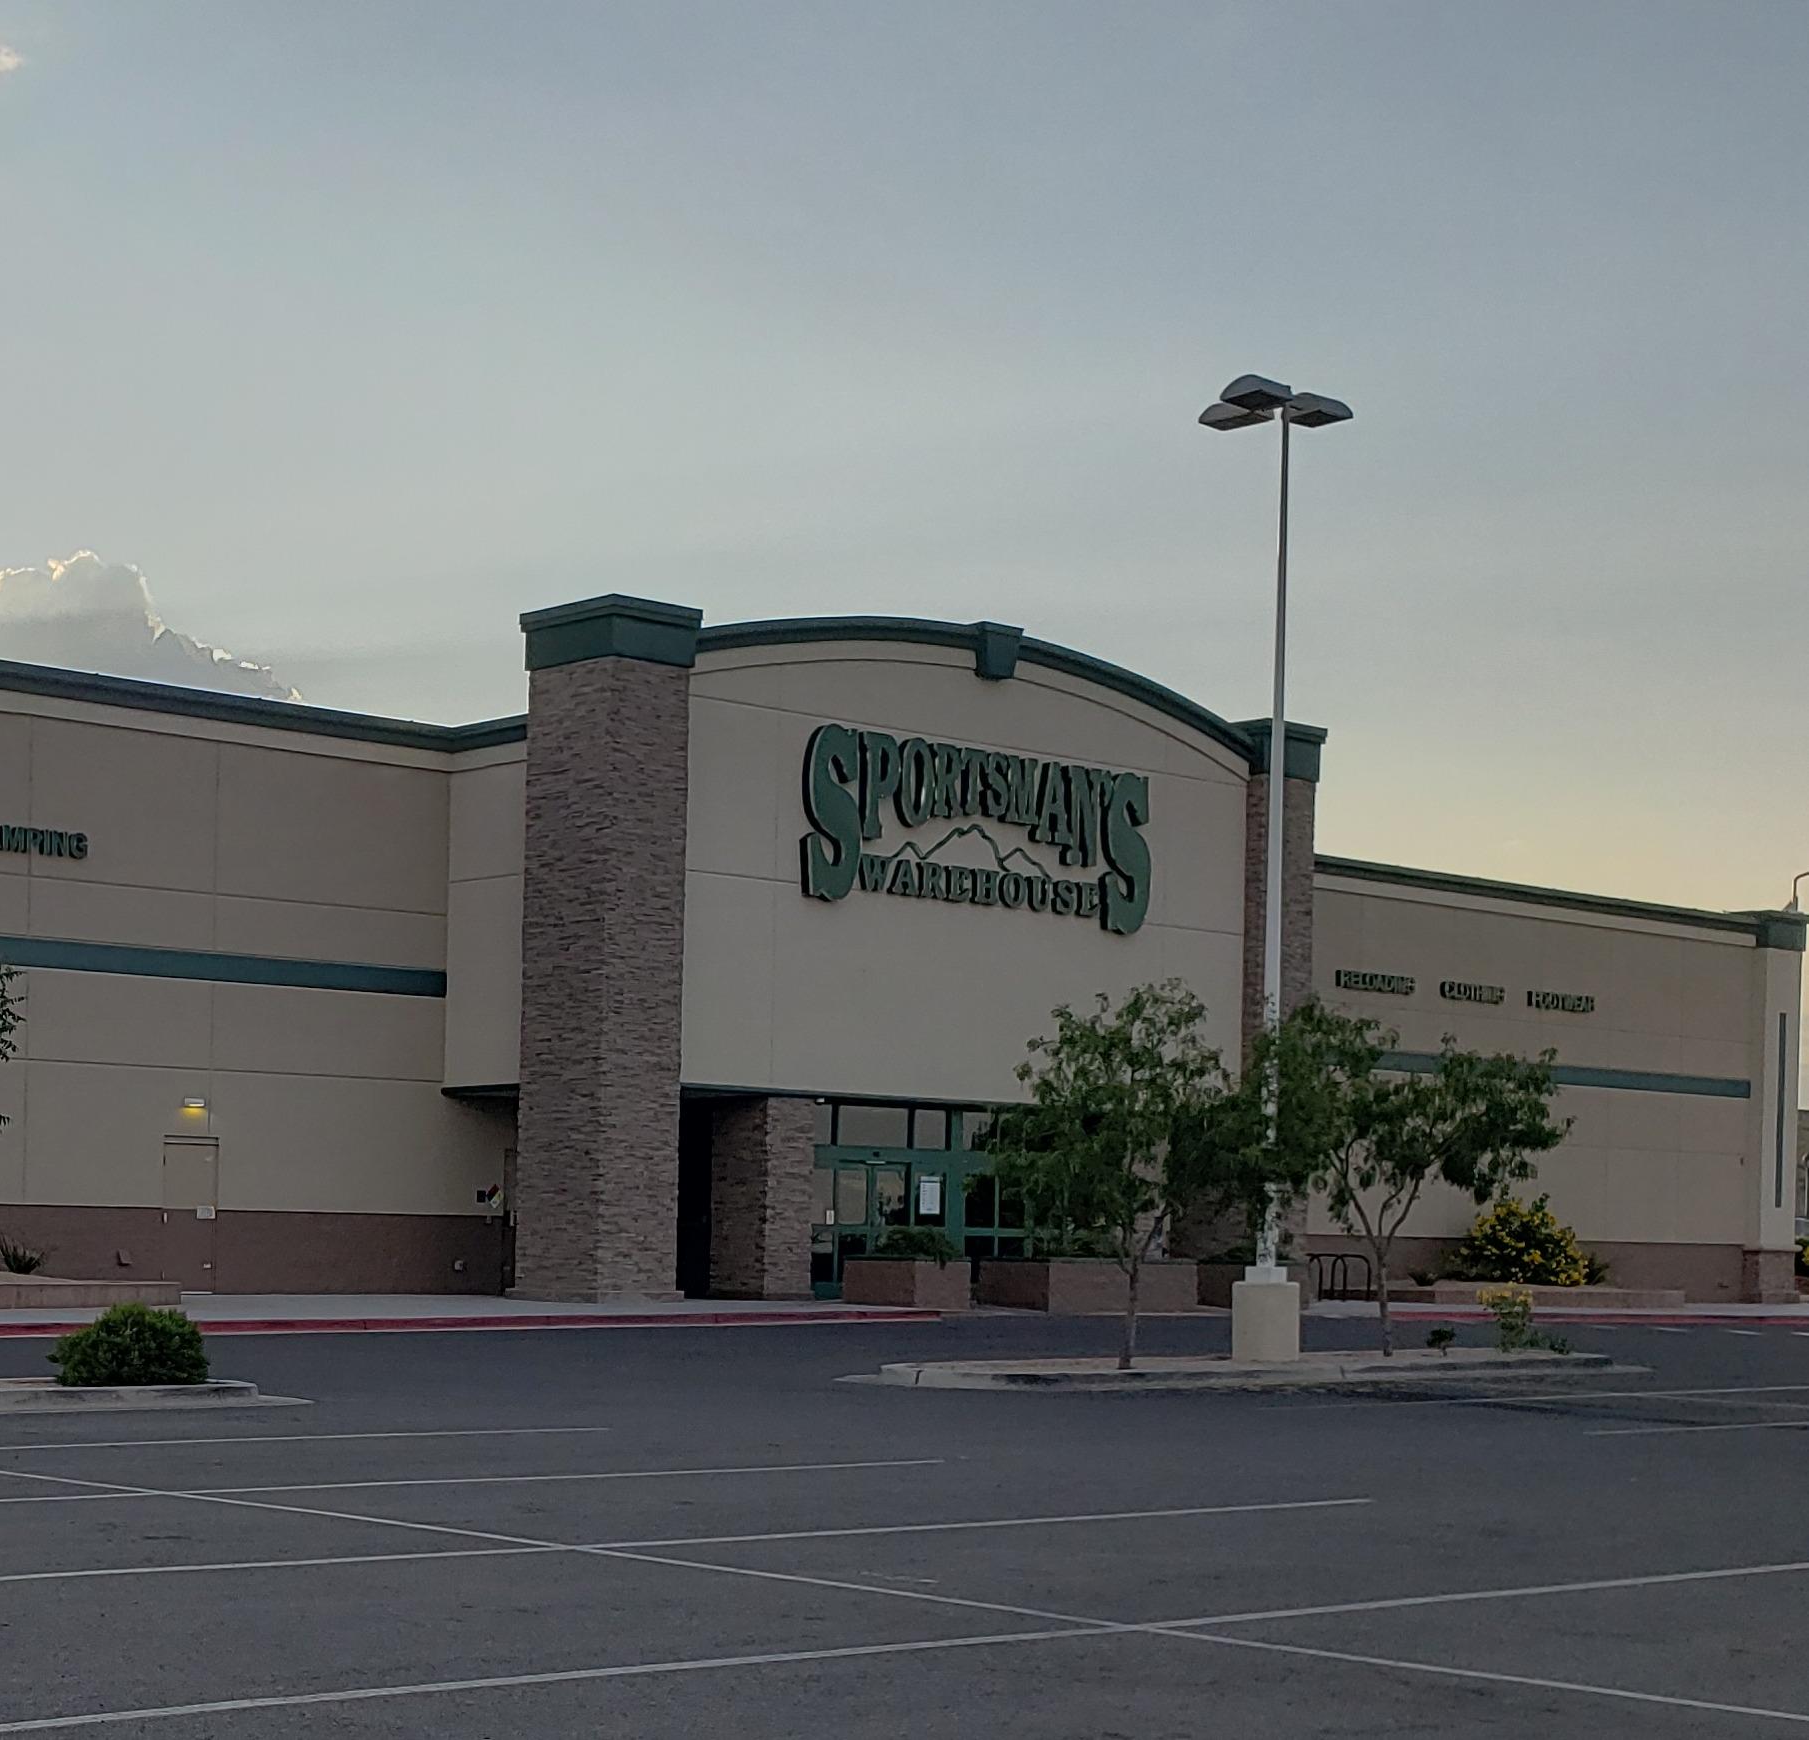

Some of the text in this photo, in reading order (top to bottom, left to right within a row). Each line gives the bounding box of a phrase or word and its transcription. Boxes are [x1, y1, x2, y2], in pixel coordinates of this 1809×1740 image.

[800, 723, 1151, 935] SPORTSMAN'S
[858, 854, 1101, 917] WAREHOUSE
[1527, 990, 1596, 1014] FOOTWEAR
